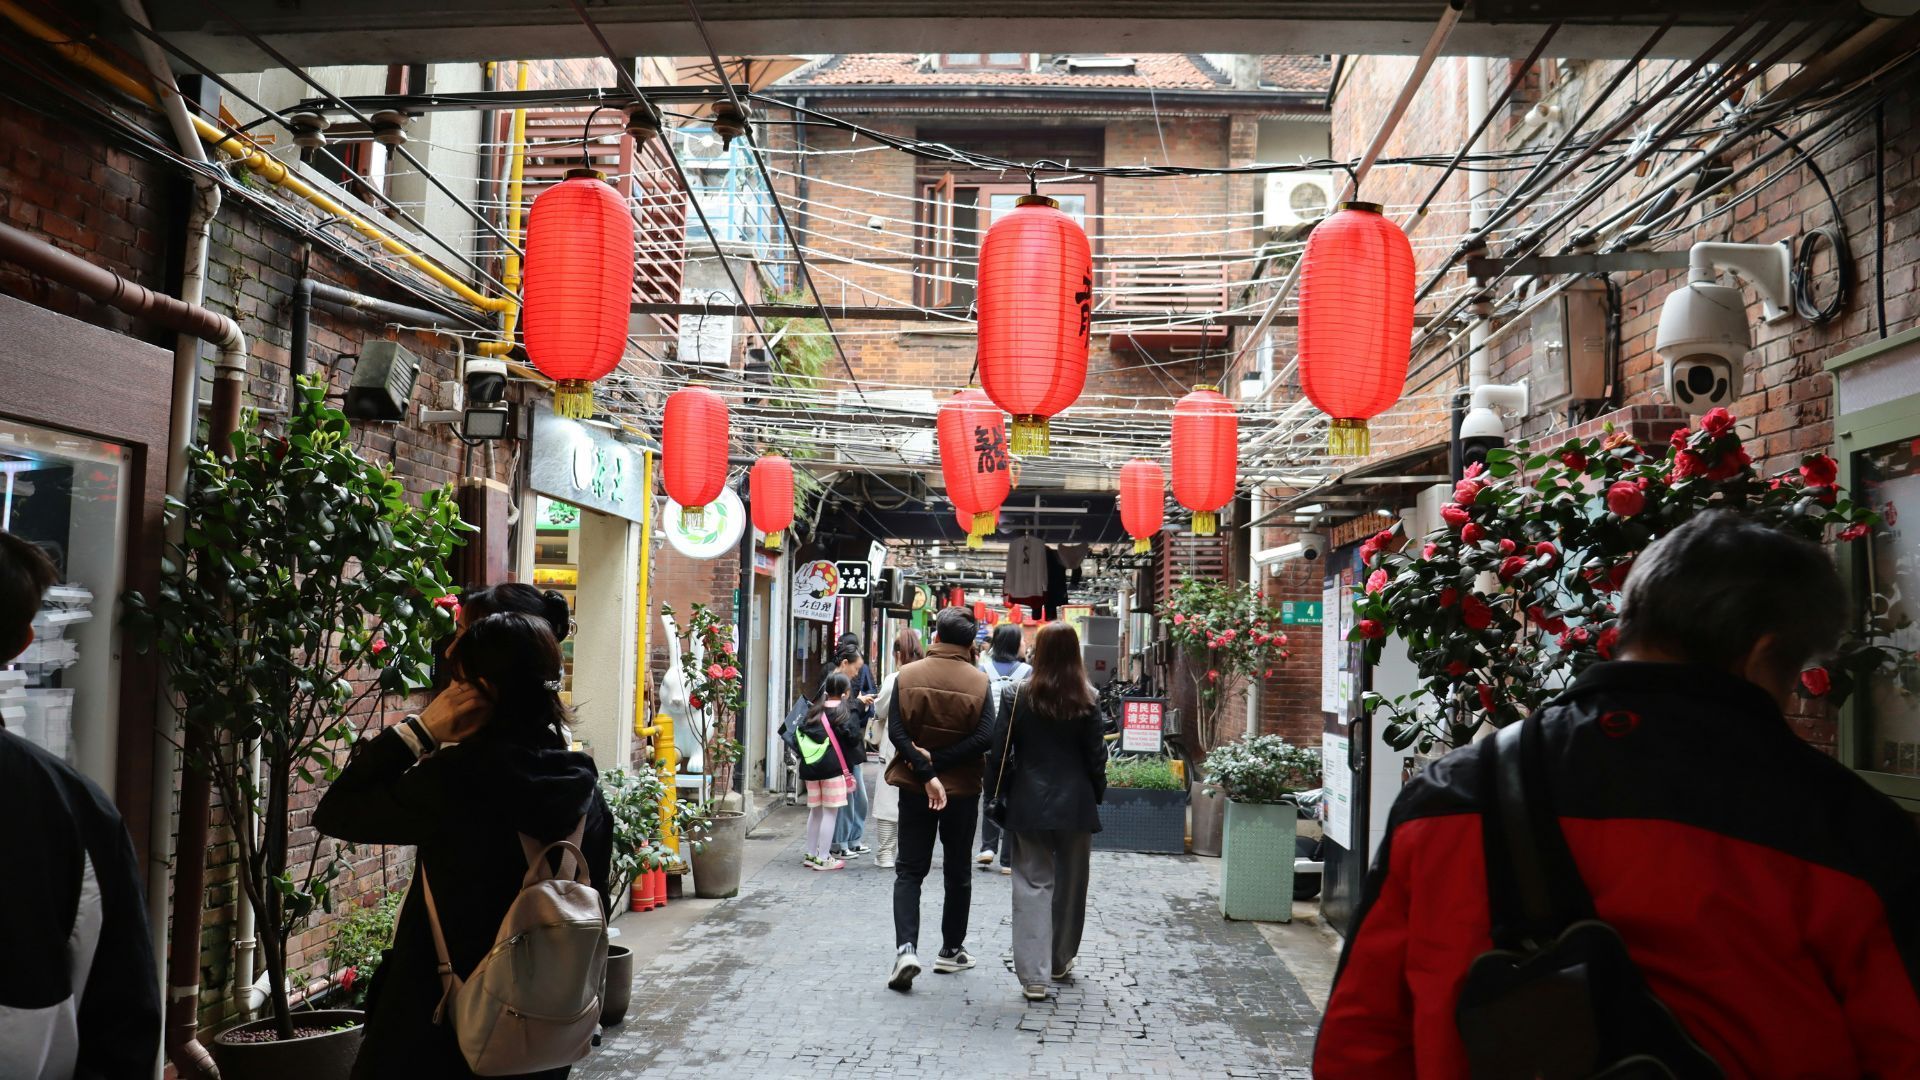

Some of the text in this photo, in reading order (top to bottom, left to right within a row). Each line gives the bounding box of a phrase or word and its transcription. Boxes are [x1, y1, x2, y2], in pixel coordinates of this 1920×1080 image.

[842, 567, 861, 576] 上海
[800, 599, 832, 612] 大白兔
[1306, 603, 1314, 617] 4
[810, 609, 832, 618] RABBIT
[1128, 702, 1160, 713] 居民区
[1127, 713, 1160, 724] 请安静
